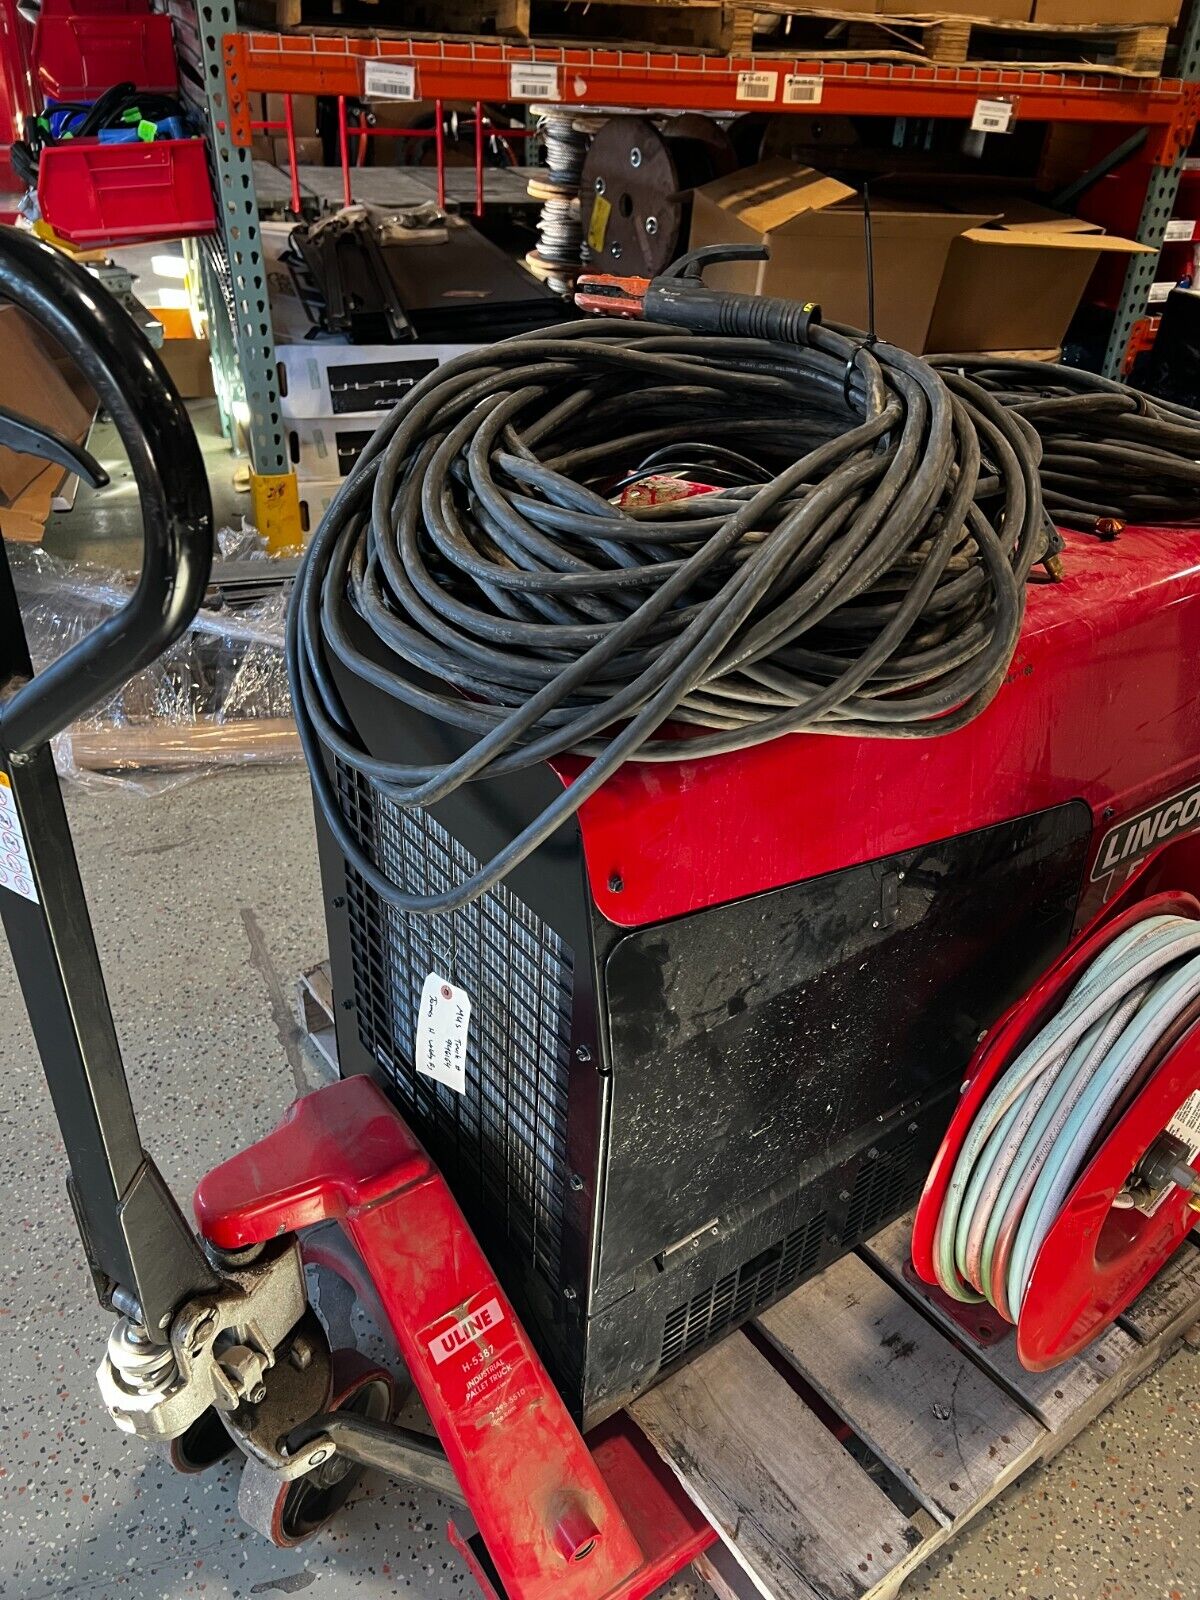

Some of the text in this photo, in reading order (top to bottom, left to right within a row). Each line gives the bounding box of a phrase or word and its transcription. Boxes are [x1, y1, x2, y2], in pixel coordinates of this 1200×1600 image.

[440, 1309, 493, 1353] ULINE
[461, 1344, 494, 1373] H-5387
[466, 1358, 505, 1390] INDUSTRIAL
[465, 1382, 489, 1402] PALLET
[488, 1364, 513, 1384] TRUCK
